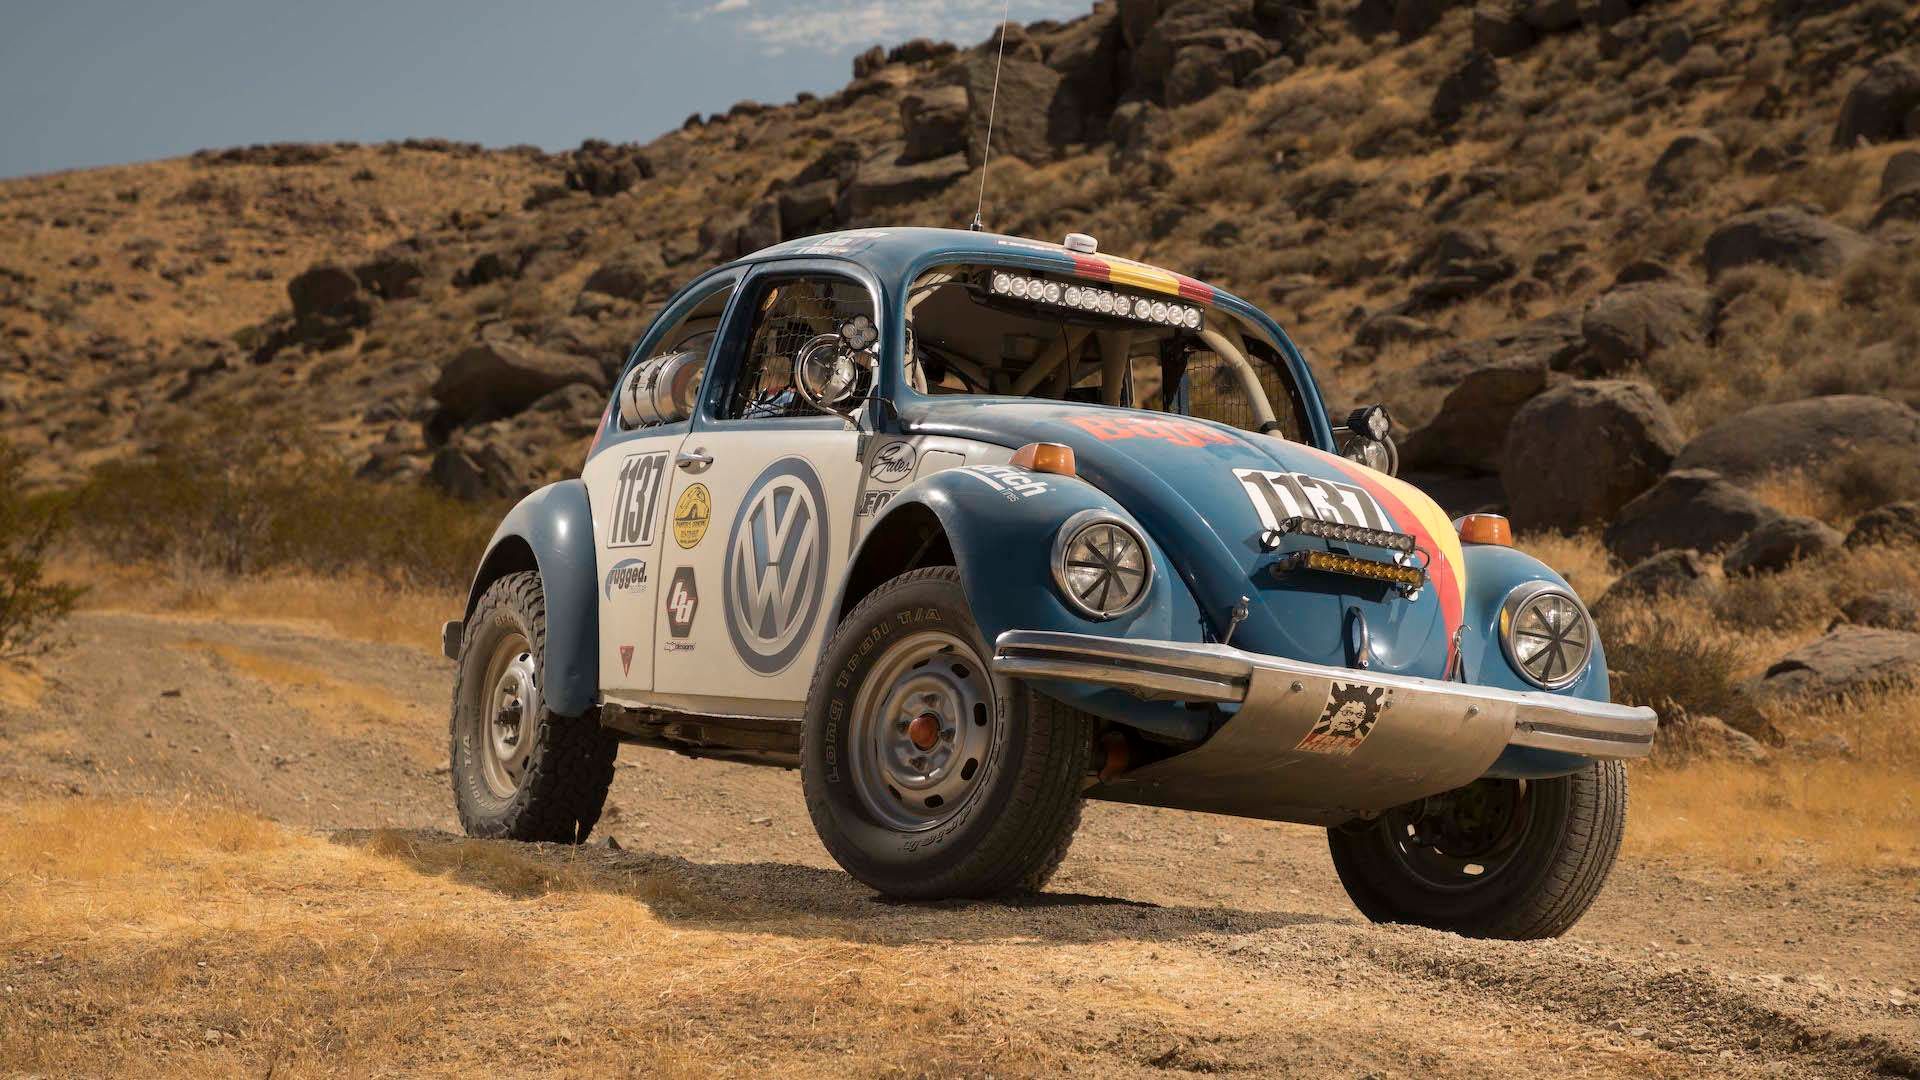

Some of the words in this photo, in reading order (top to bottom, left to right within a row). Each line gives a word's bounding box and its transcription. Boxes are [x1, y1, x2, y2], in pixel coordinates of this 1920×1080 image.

[870, 445, 912, 478] Gates
[612, 456, 666, 543] 1137
[857, 490, 901, 518] FO
[1241, 471, 1384, 531] 1137
[898, 607, 945, 624] T/A
